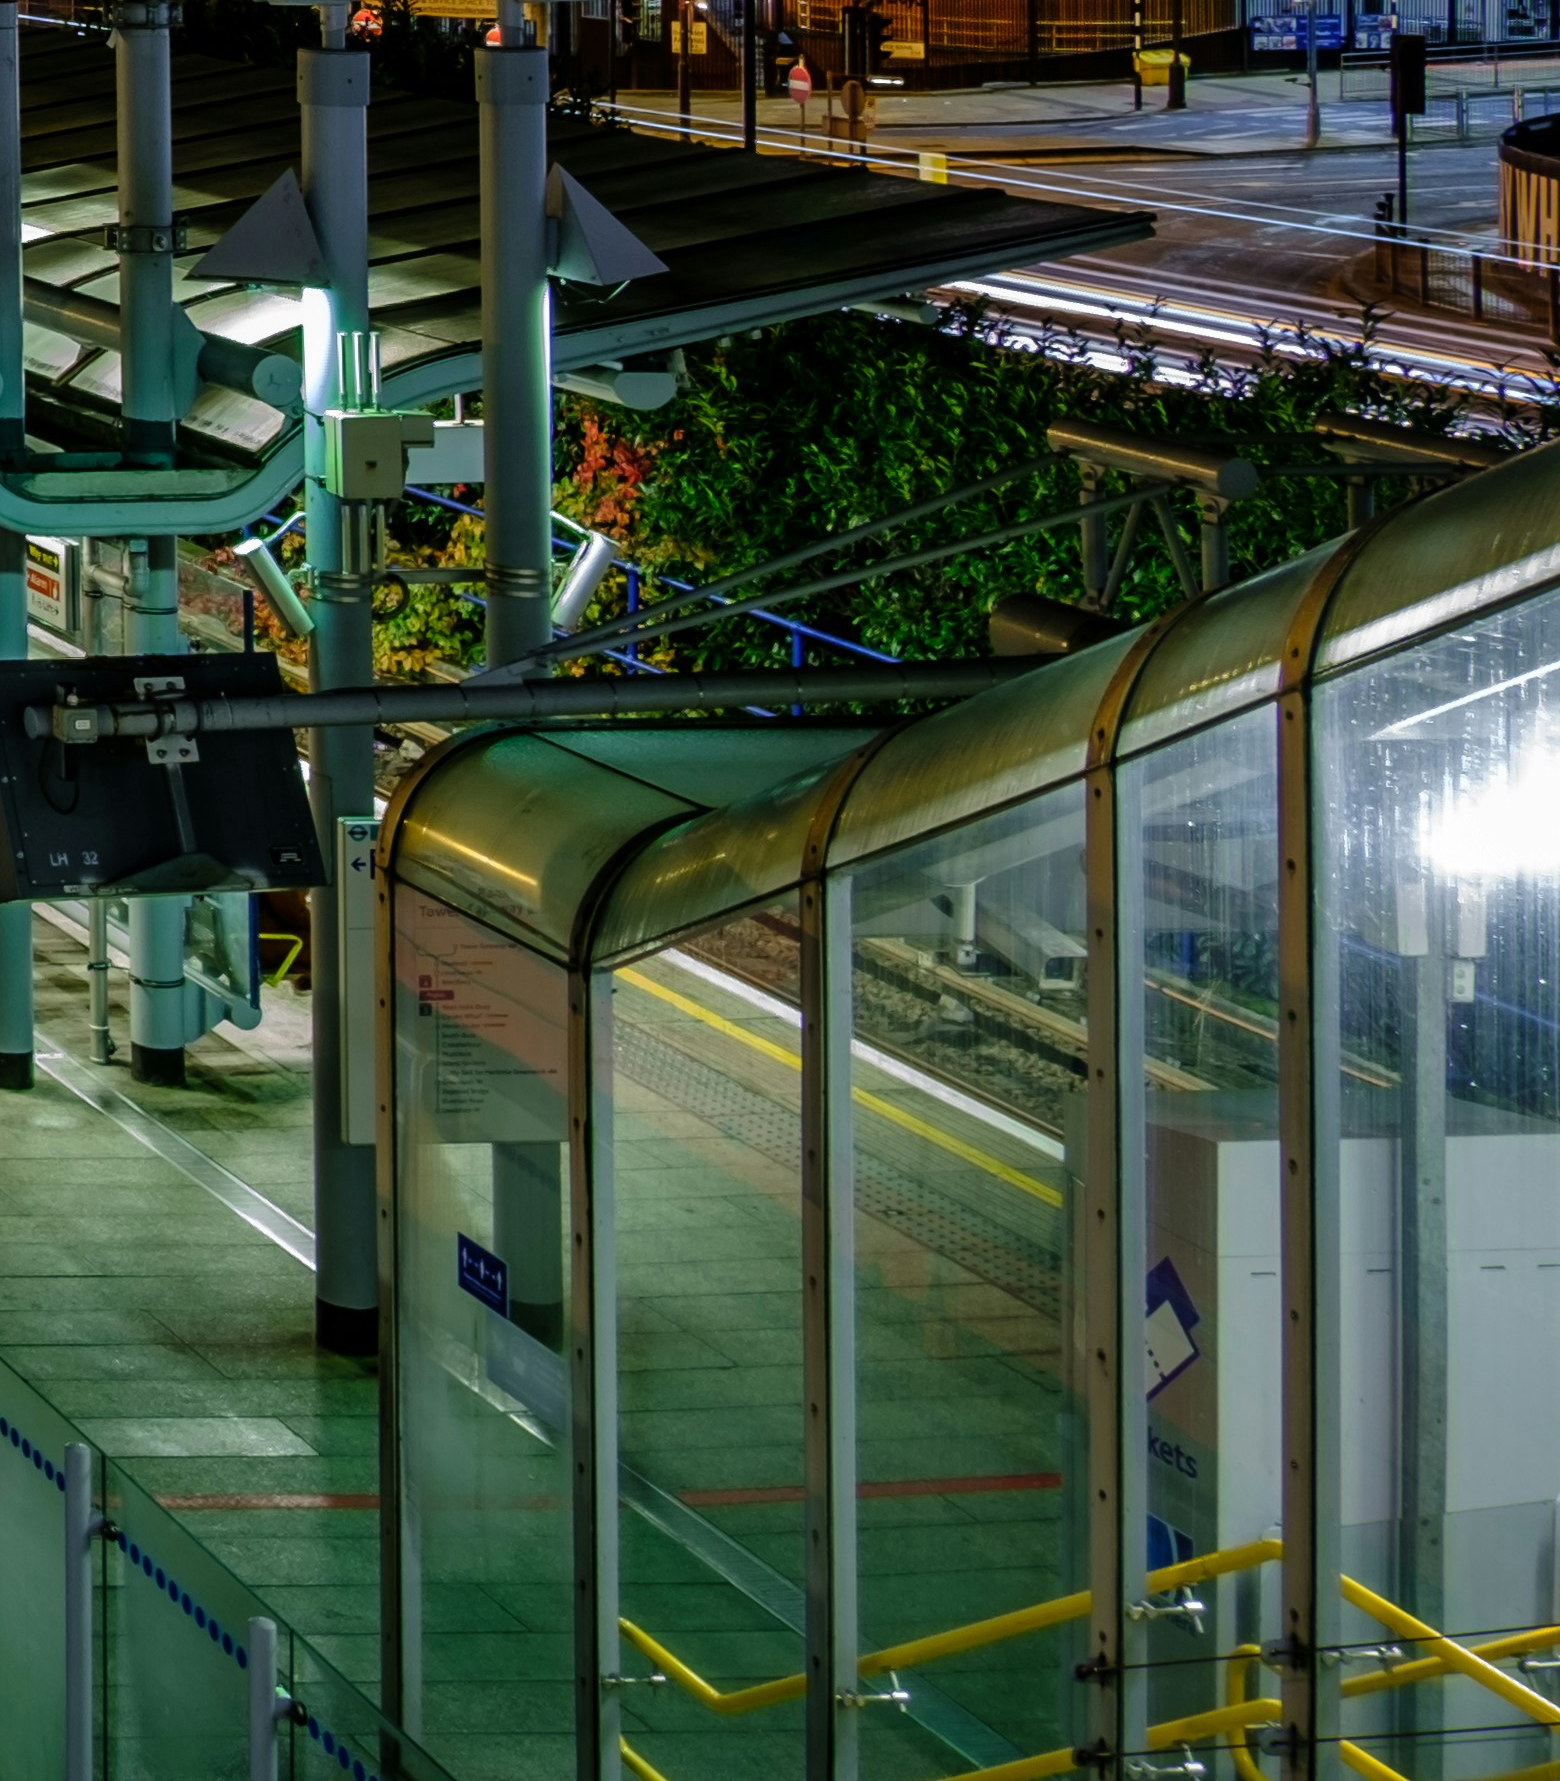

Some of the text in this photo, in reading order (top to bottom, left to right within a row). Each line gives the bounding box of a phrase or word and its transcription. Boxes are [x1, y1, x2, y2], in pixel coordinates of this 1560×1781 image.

[49, 851, 99, 867] LH 32
[1148, 1425, 1198, 1479] kets
